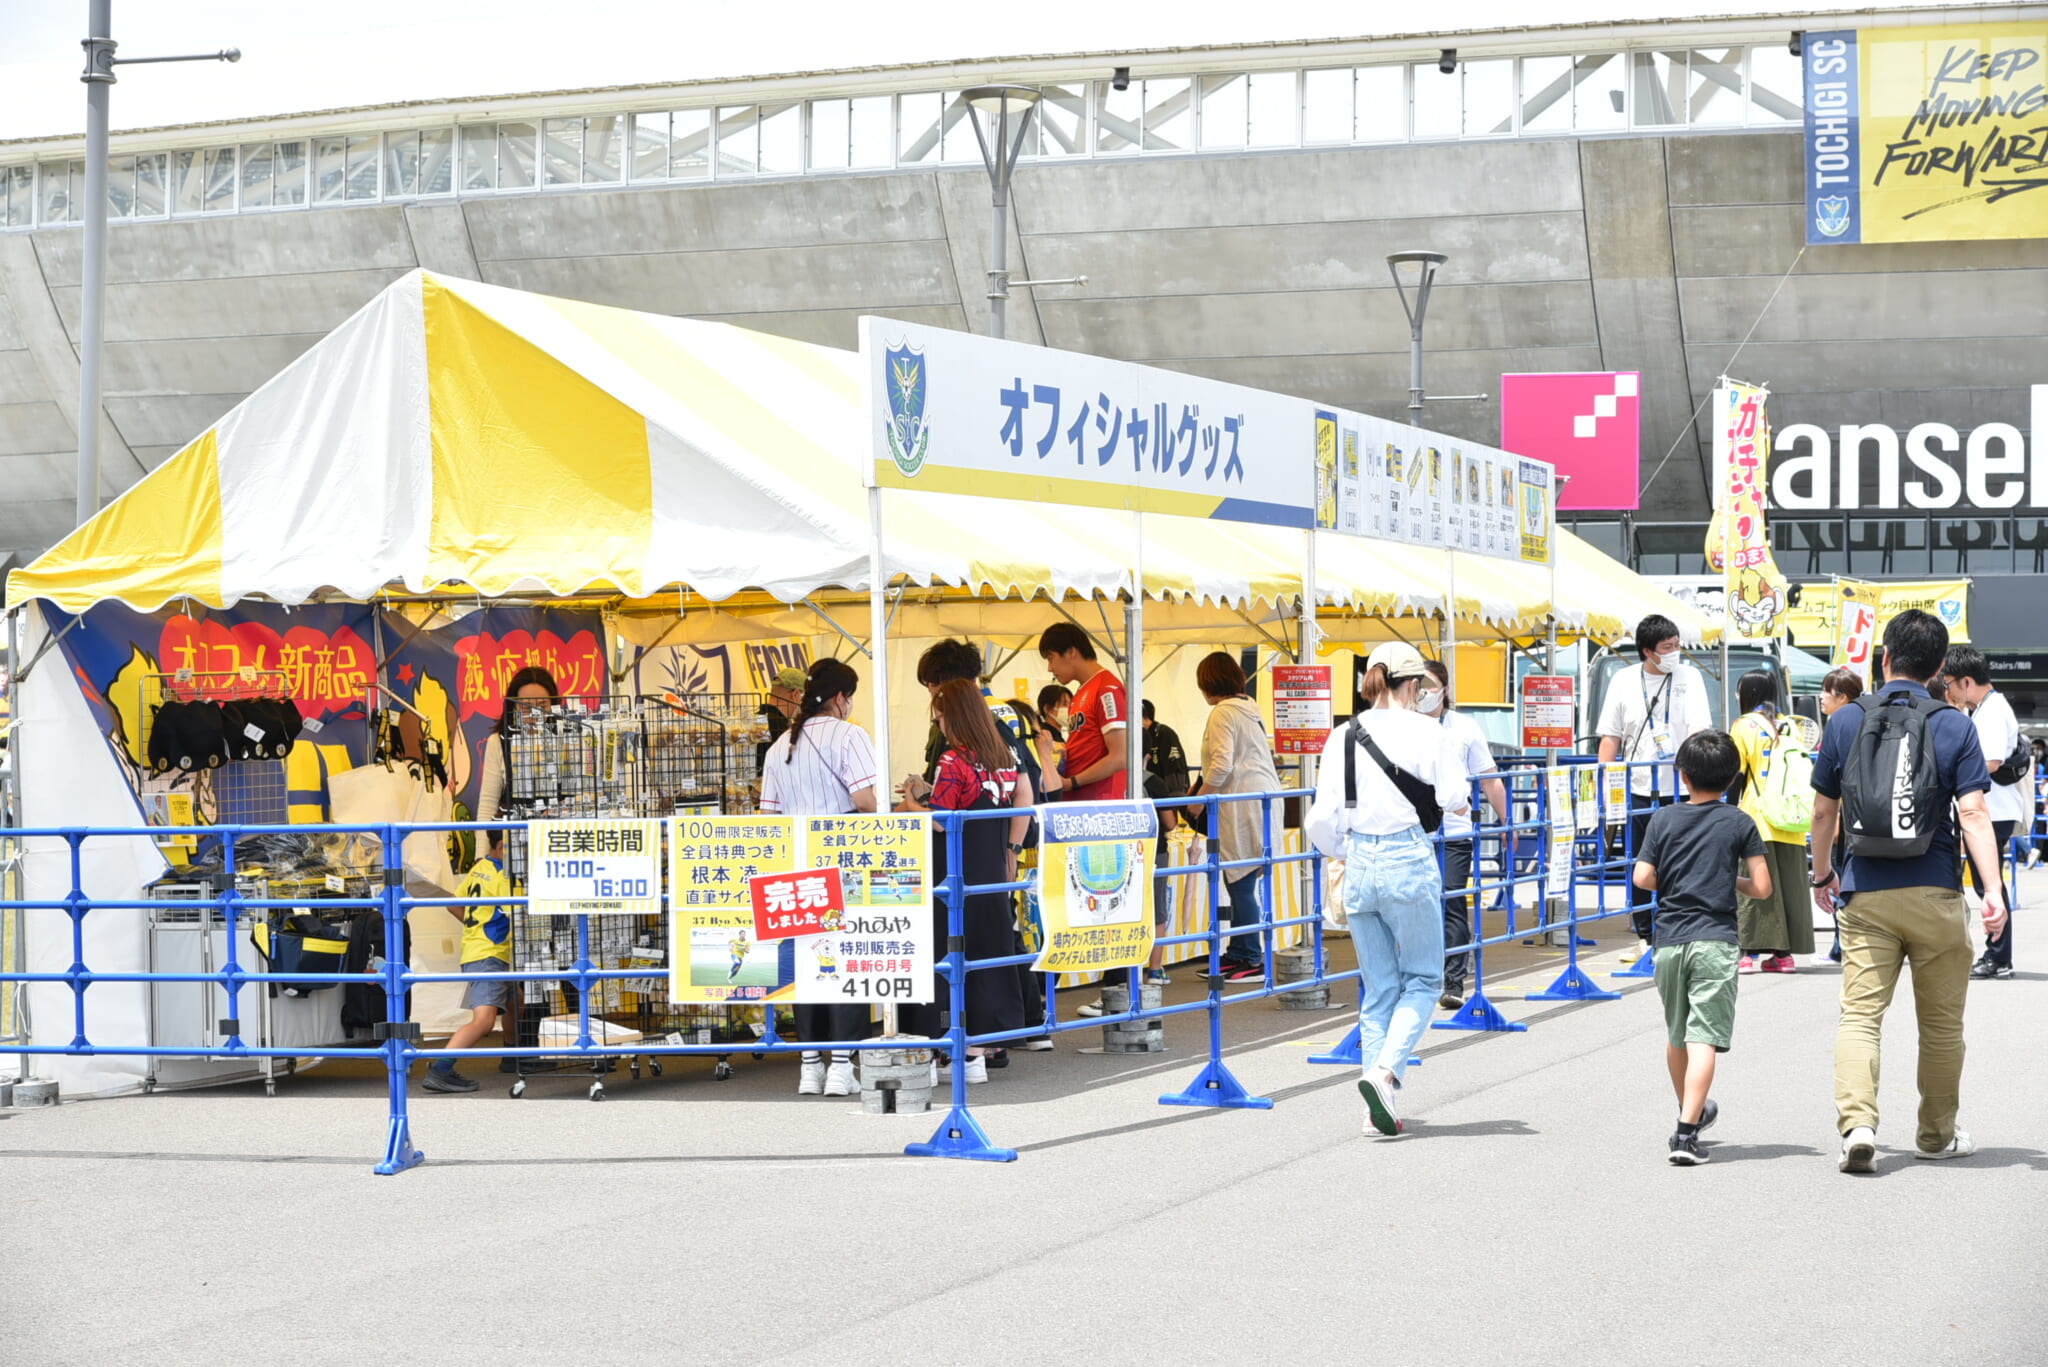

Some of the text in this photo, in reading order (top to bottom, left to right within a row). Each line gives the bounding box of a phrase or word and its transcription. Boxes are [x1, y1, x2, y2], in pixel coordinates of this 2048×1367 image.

[1928, 45, 2040, 99] KEEP
[1812, 39, 1850, 189] TOCHIGI SC
[1902, 84, 2048, 141] MOVING
[1000, 377, 1245, 485] オフィシャルグッズ
[810, 819, 922, 832] 直筆サイン入り写真
[548, 829, 643, 853] 営業時間
[823, 834, 908, 847] 全員プレゼント
[545, 860, 606, 879] 11:00-
[815, 855, 832, 868] 37
[838, 851, 874, 869] 根本
[691, 865, 731, 885] 根本
[593, 879, 648, 897] 16:00
[763, 876, 830, 915] 完売
[768, 911, 818, 931] しました
[840, 940, 916, 956] 特別販売会
[842, 977, 913, 998] 410円
